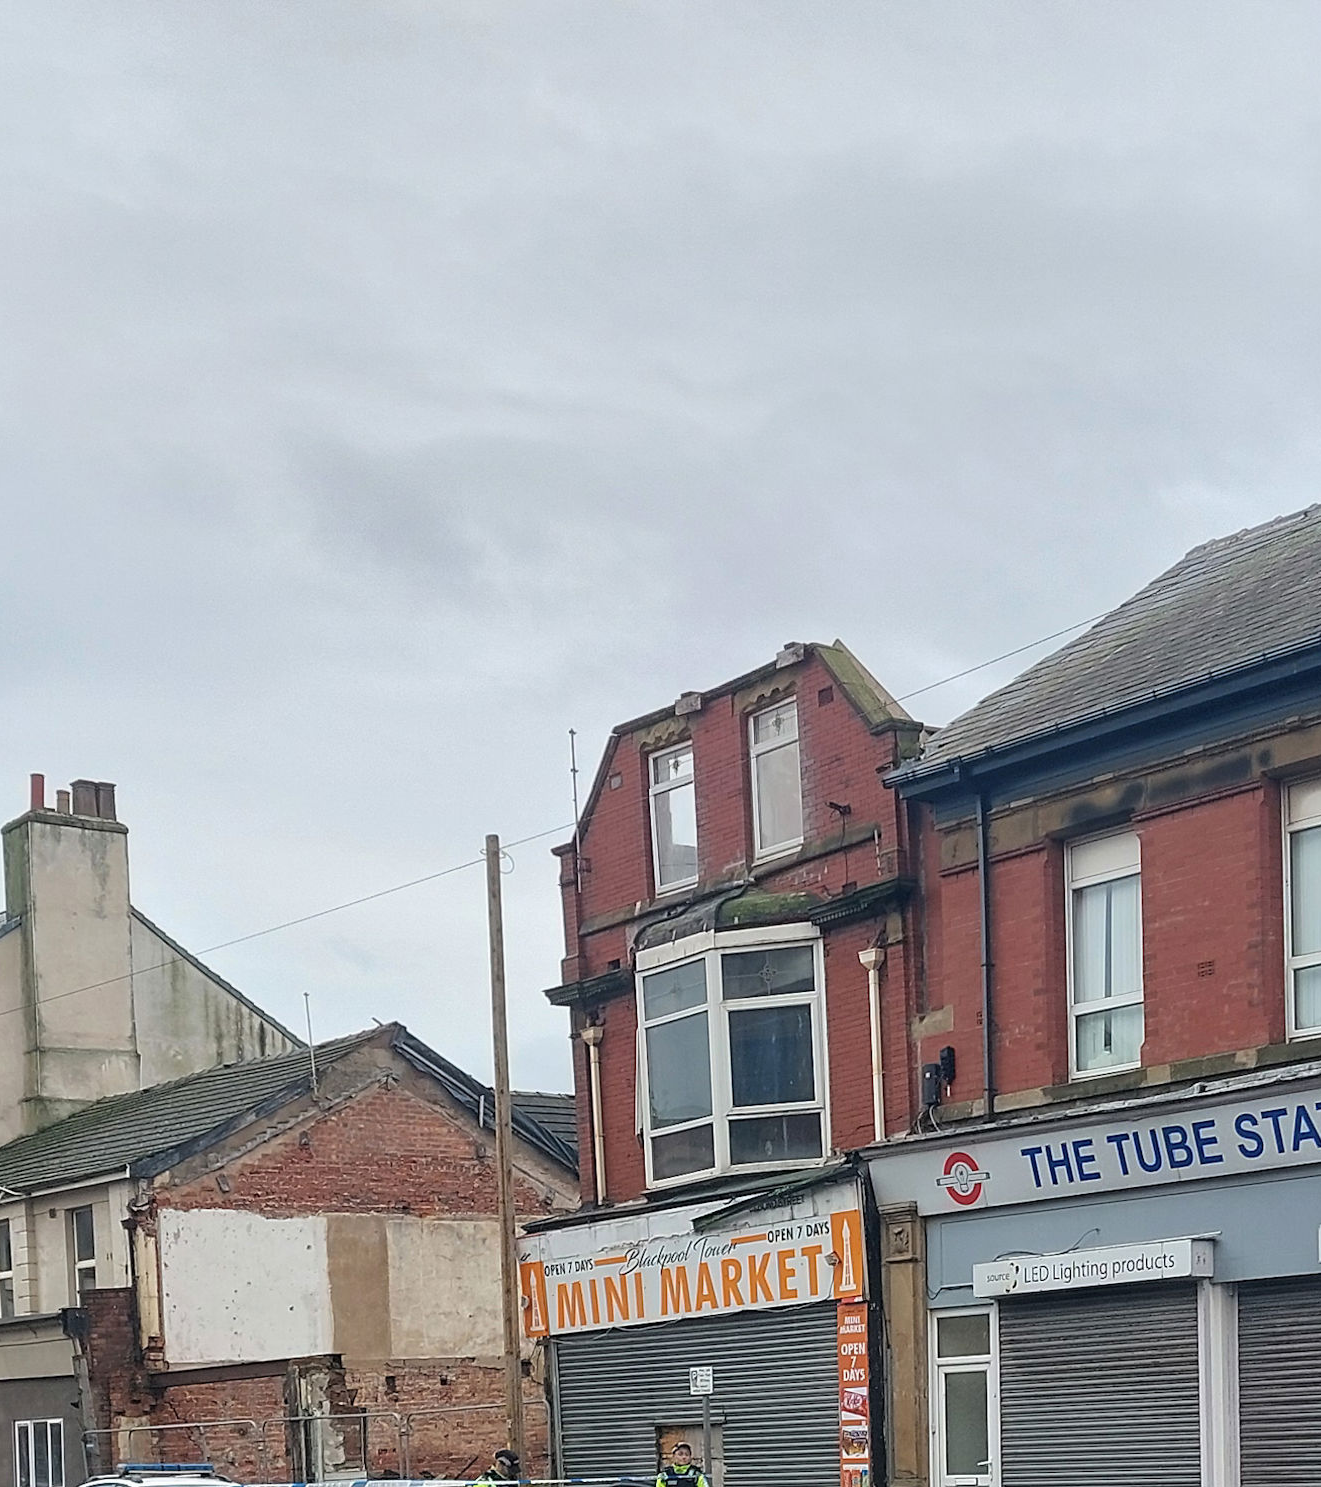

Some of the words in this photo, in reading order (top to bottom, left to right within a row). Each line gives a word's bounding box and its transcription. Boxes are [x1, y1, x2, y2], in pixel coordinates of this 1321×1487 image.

[1021, 1138, 1102, 1188] THE
[1107, 1119, 1224, 1176] TUBE
[767, 1229, 794, 1244] OPEN
[796, 1226, 803, 1240] 7
[805, 1221, 830, 1238] DAYS
[544, 1260, 566, 1278] OPEN
[568, 1260, 574, 1275] 7
[574, 1258, 594, 1274] DAYS
[619, 1240, 691, 1276] Blackpool
[986, 1272, 1012, 1284] source
[1023, 1265, 1050, 1284] LED
[1052, 1260, 1108, 1284] Lighting
[1112, 1252, 1175, 1278] products
[557, 1272, 645, 1329] MINI
[660, 1244, 824, 1316] MARKET
[839, 1324, 866, 1335] MARKET
[844, 1315, 861, 1325] MINI
[840, 1342, 866, 1355] OPEN
[850, 1355, 857, 1368] 7
[843, 1368, 866, 1382] DAYS
